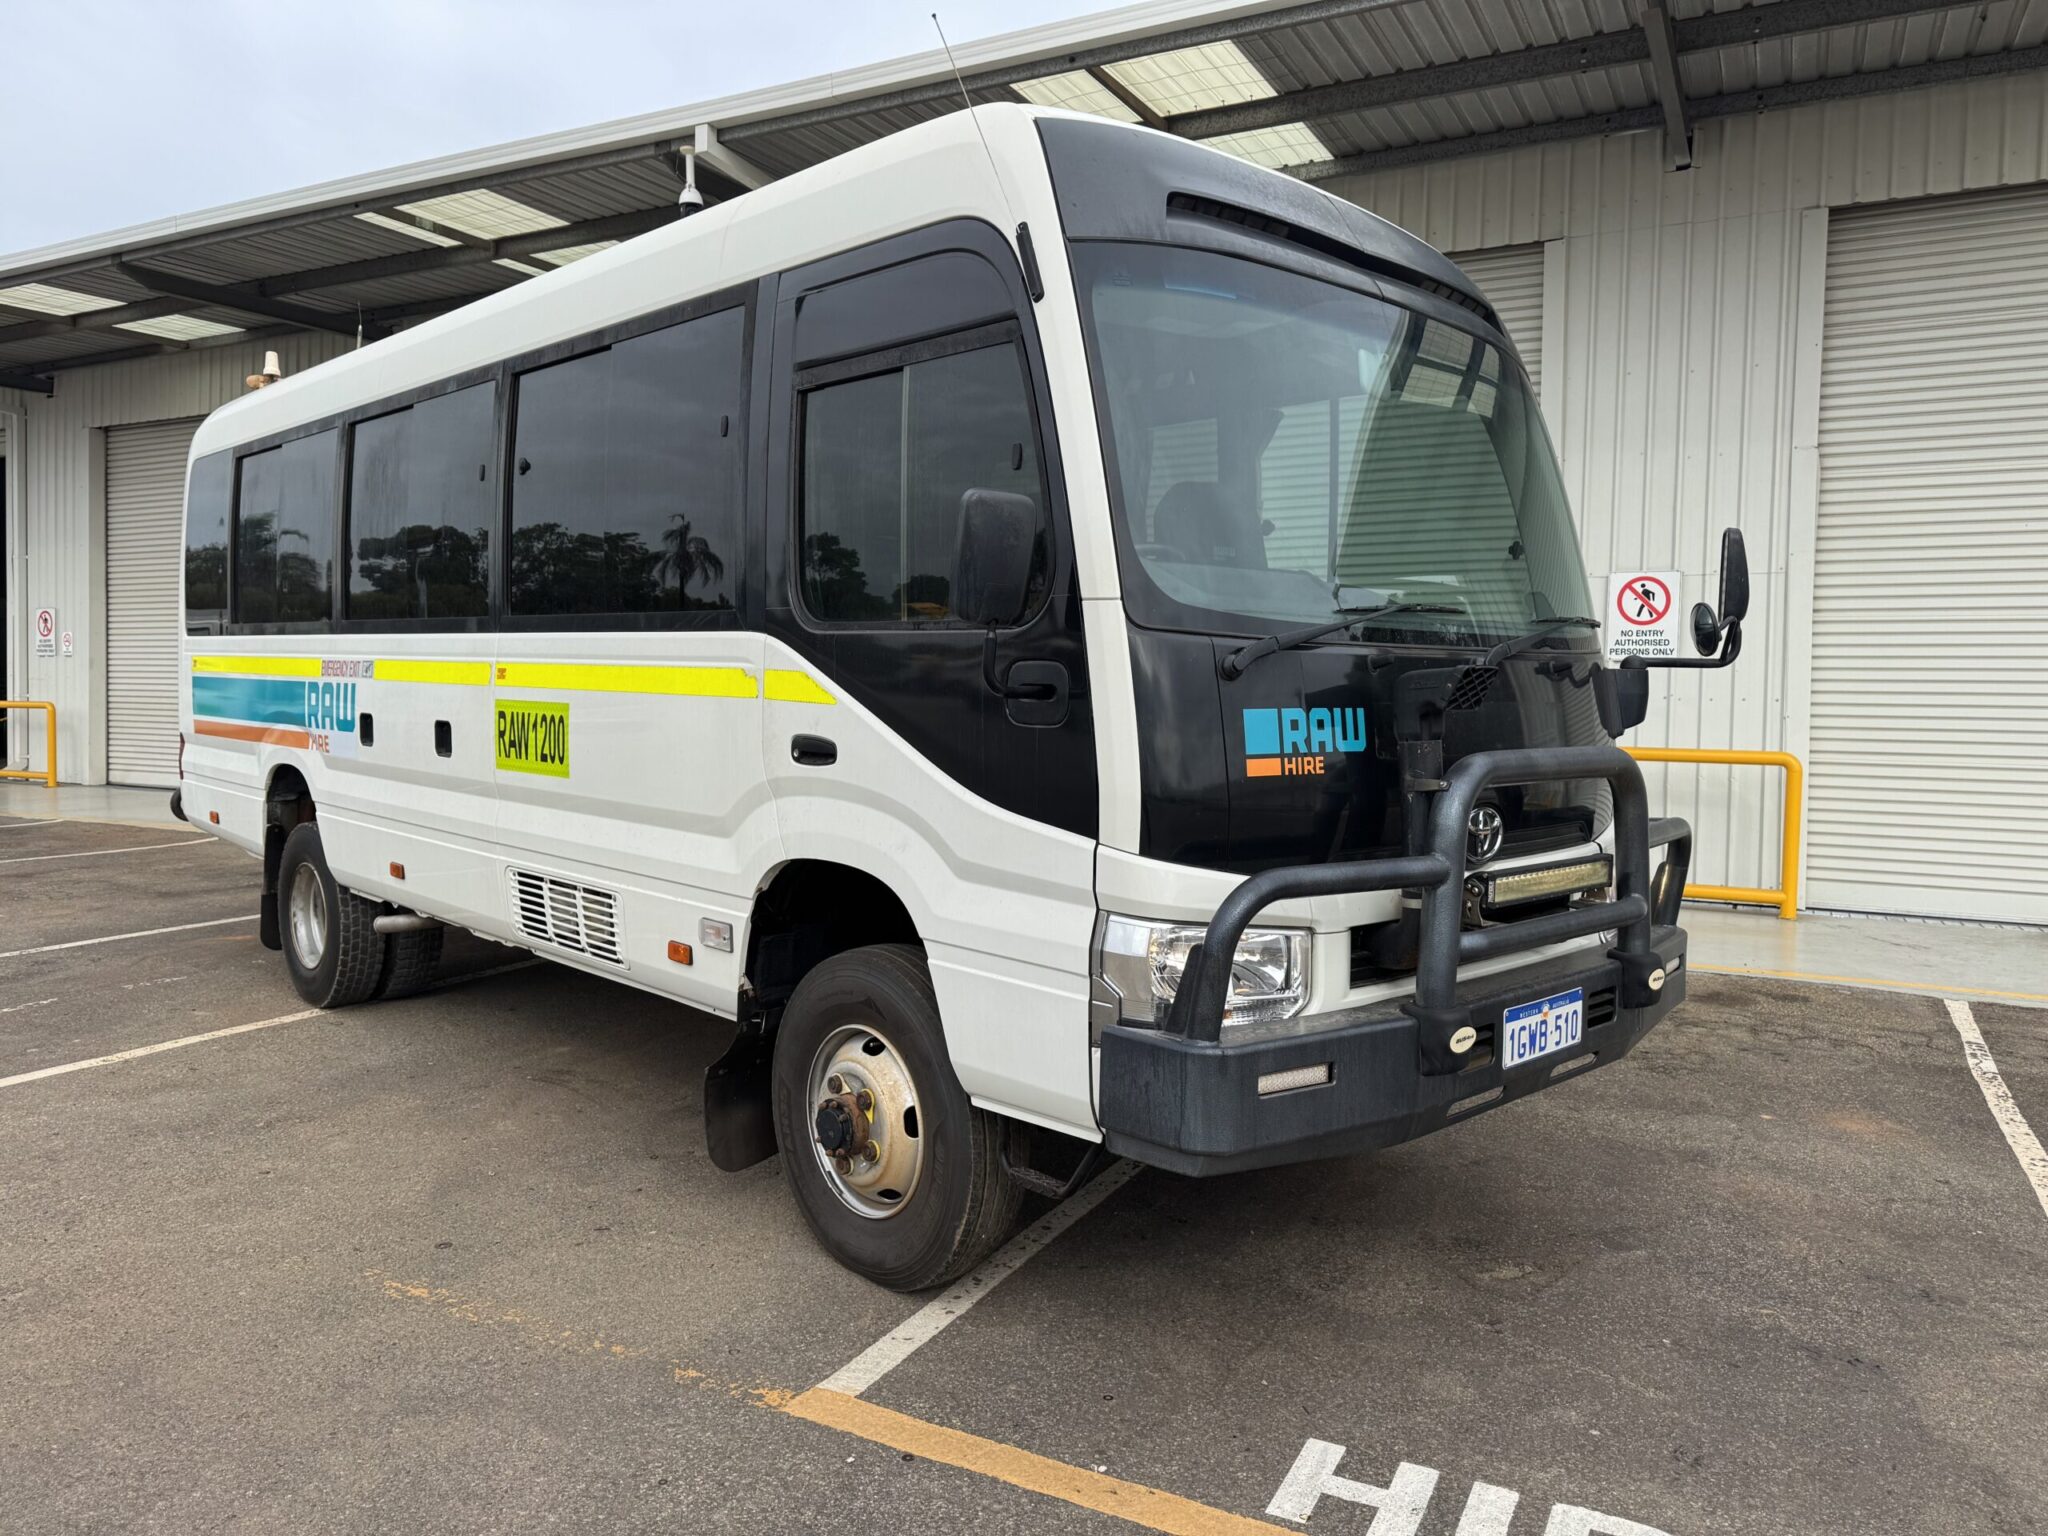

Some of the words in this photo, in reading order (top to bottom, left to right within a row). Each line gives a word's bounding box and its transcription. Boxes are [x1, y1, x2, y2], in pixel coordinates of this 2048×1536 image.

[1635, 629, 1664, 637] ENTRY
[1614, 638, 1670, 647] AUTHORISED
[1609, 648, 1650, 656] PERSONS
[1652, 648, 1675, 656] ONLY
[307, 681, 356, 732] RAW
[1281, 707, 1367, 754] RAW
[1284, 756, 1325, 776] HIRE
